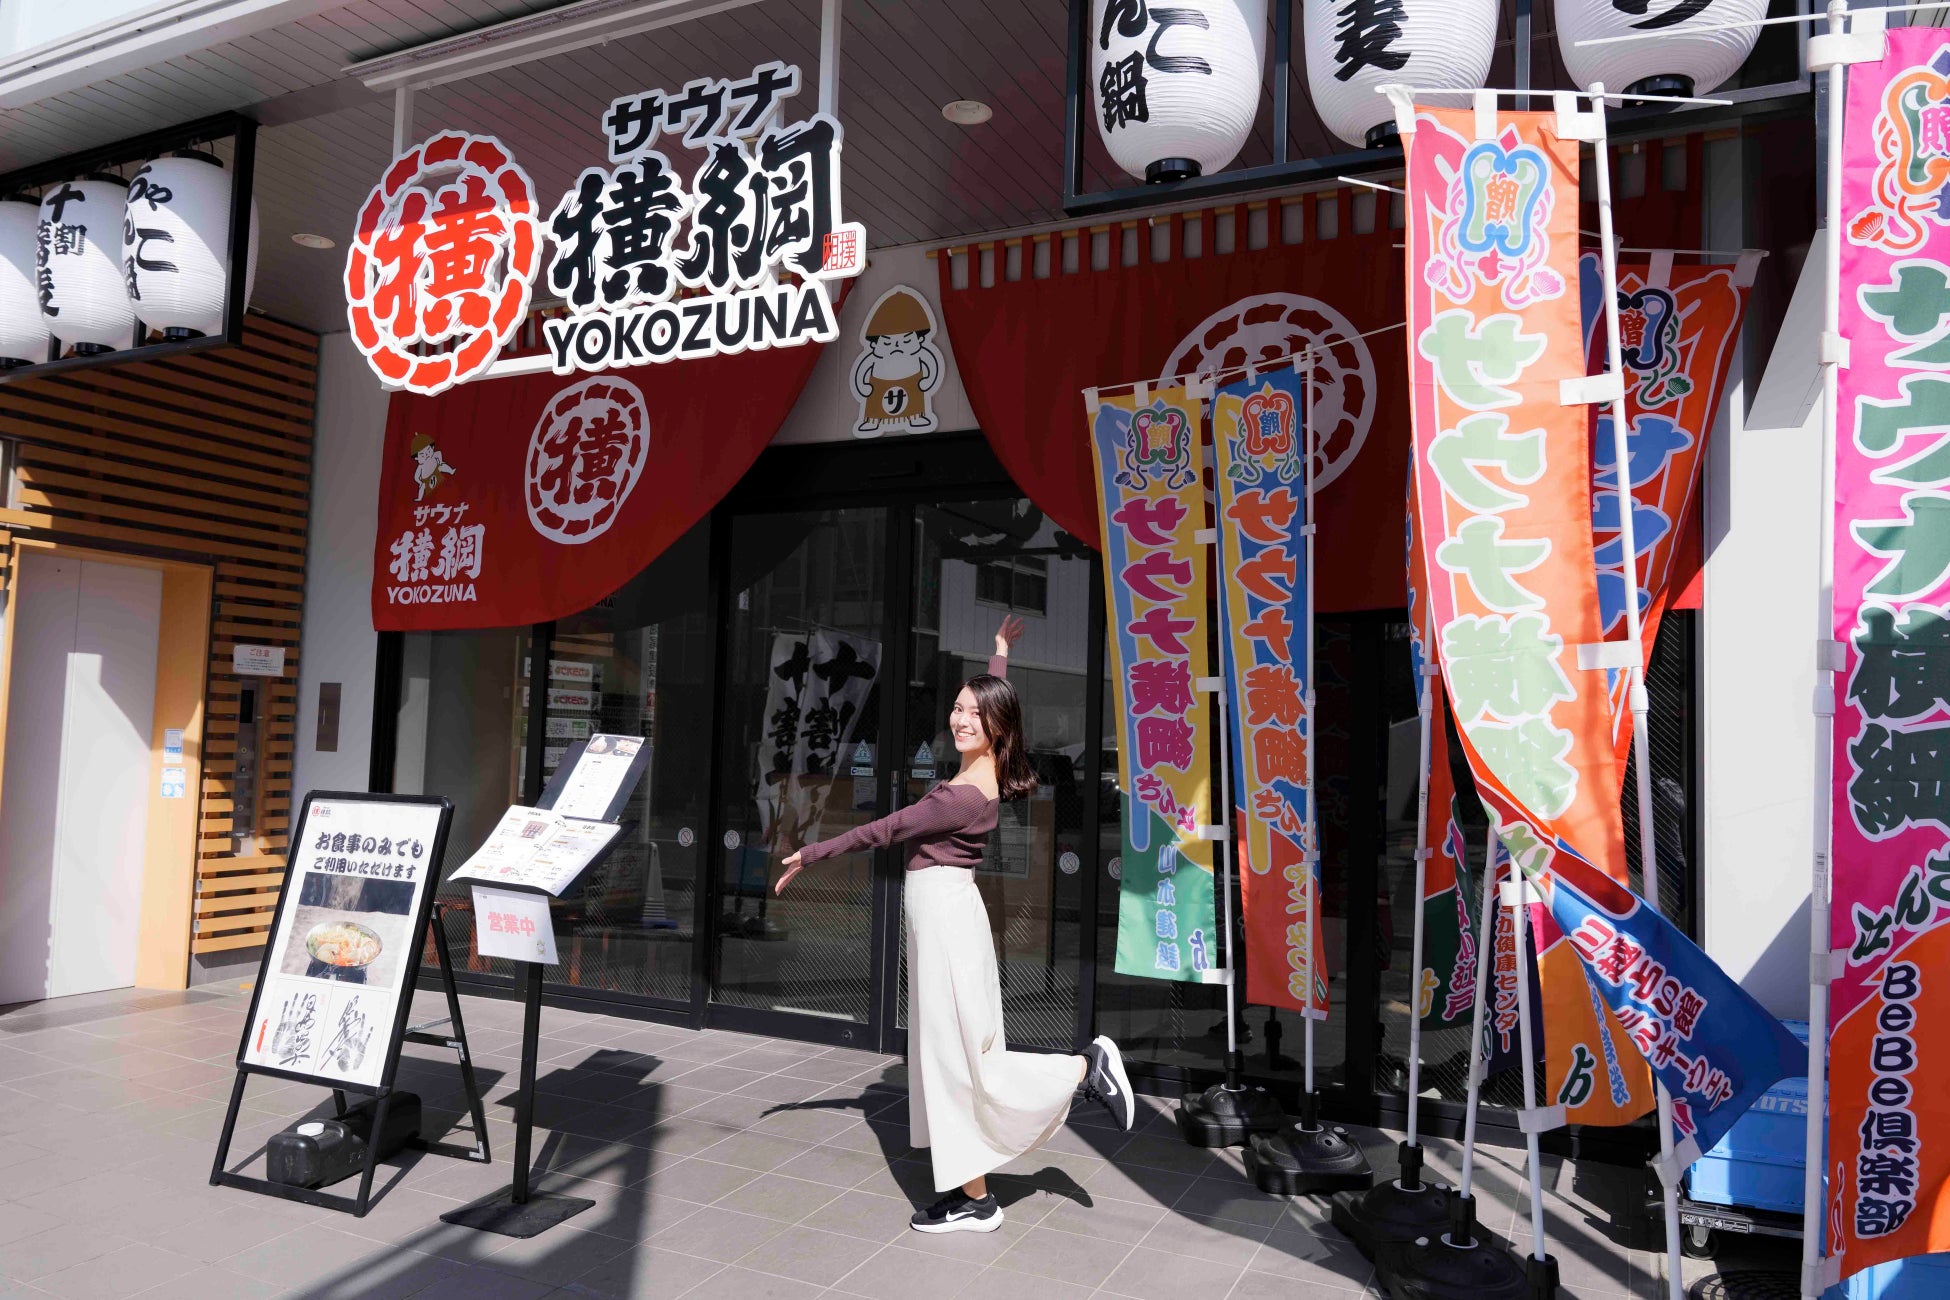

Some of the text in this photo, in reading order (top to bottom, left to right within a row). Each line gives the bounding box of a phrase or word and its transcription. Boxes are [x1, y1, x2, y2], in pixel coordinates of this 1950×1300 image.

[607, 68, 798, 155] サウナ
[549, 120, 835, 307] 横綱
[375, 175, 507, 341] 横
[550, 288, 829, 369] YOKOZUNA
[884, 388, 906, 414] サ
[413, 502, 469, 526] サウナ
[389, 524, 485, 582] 横綱
[387, 583, 477, 605] YOKOZUNA
[315, 831, 424, 859] お食事のみでも
[313, 856, 417, 880] ご利用いただけます
[488, 911, 535, 937] 営業中
